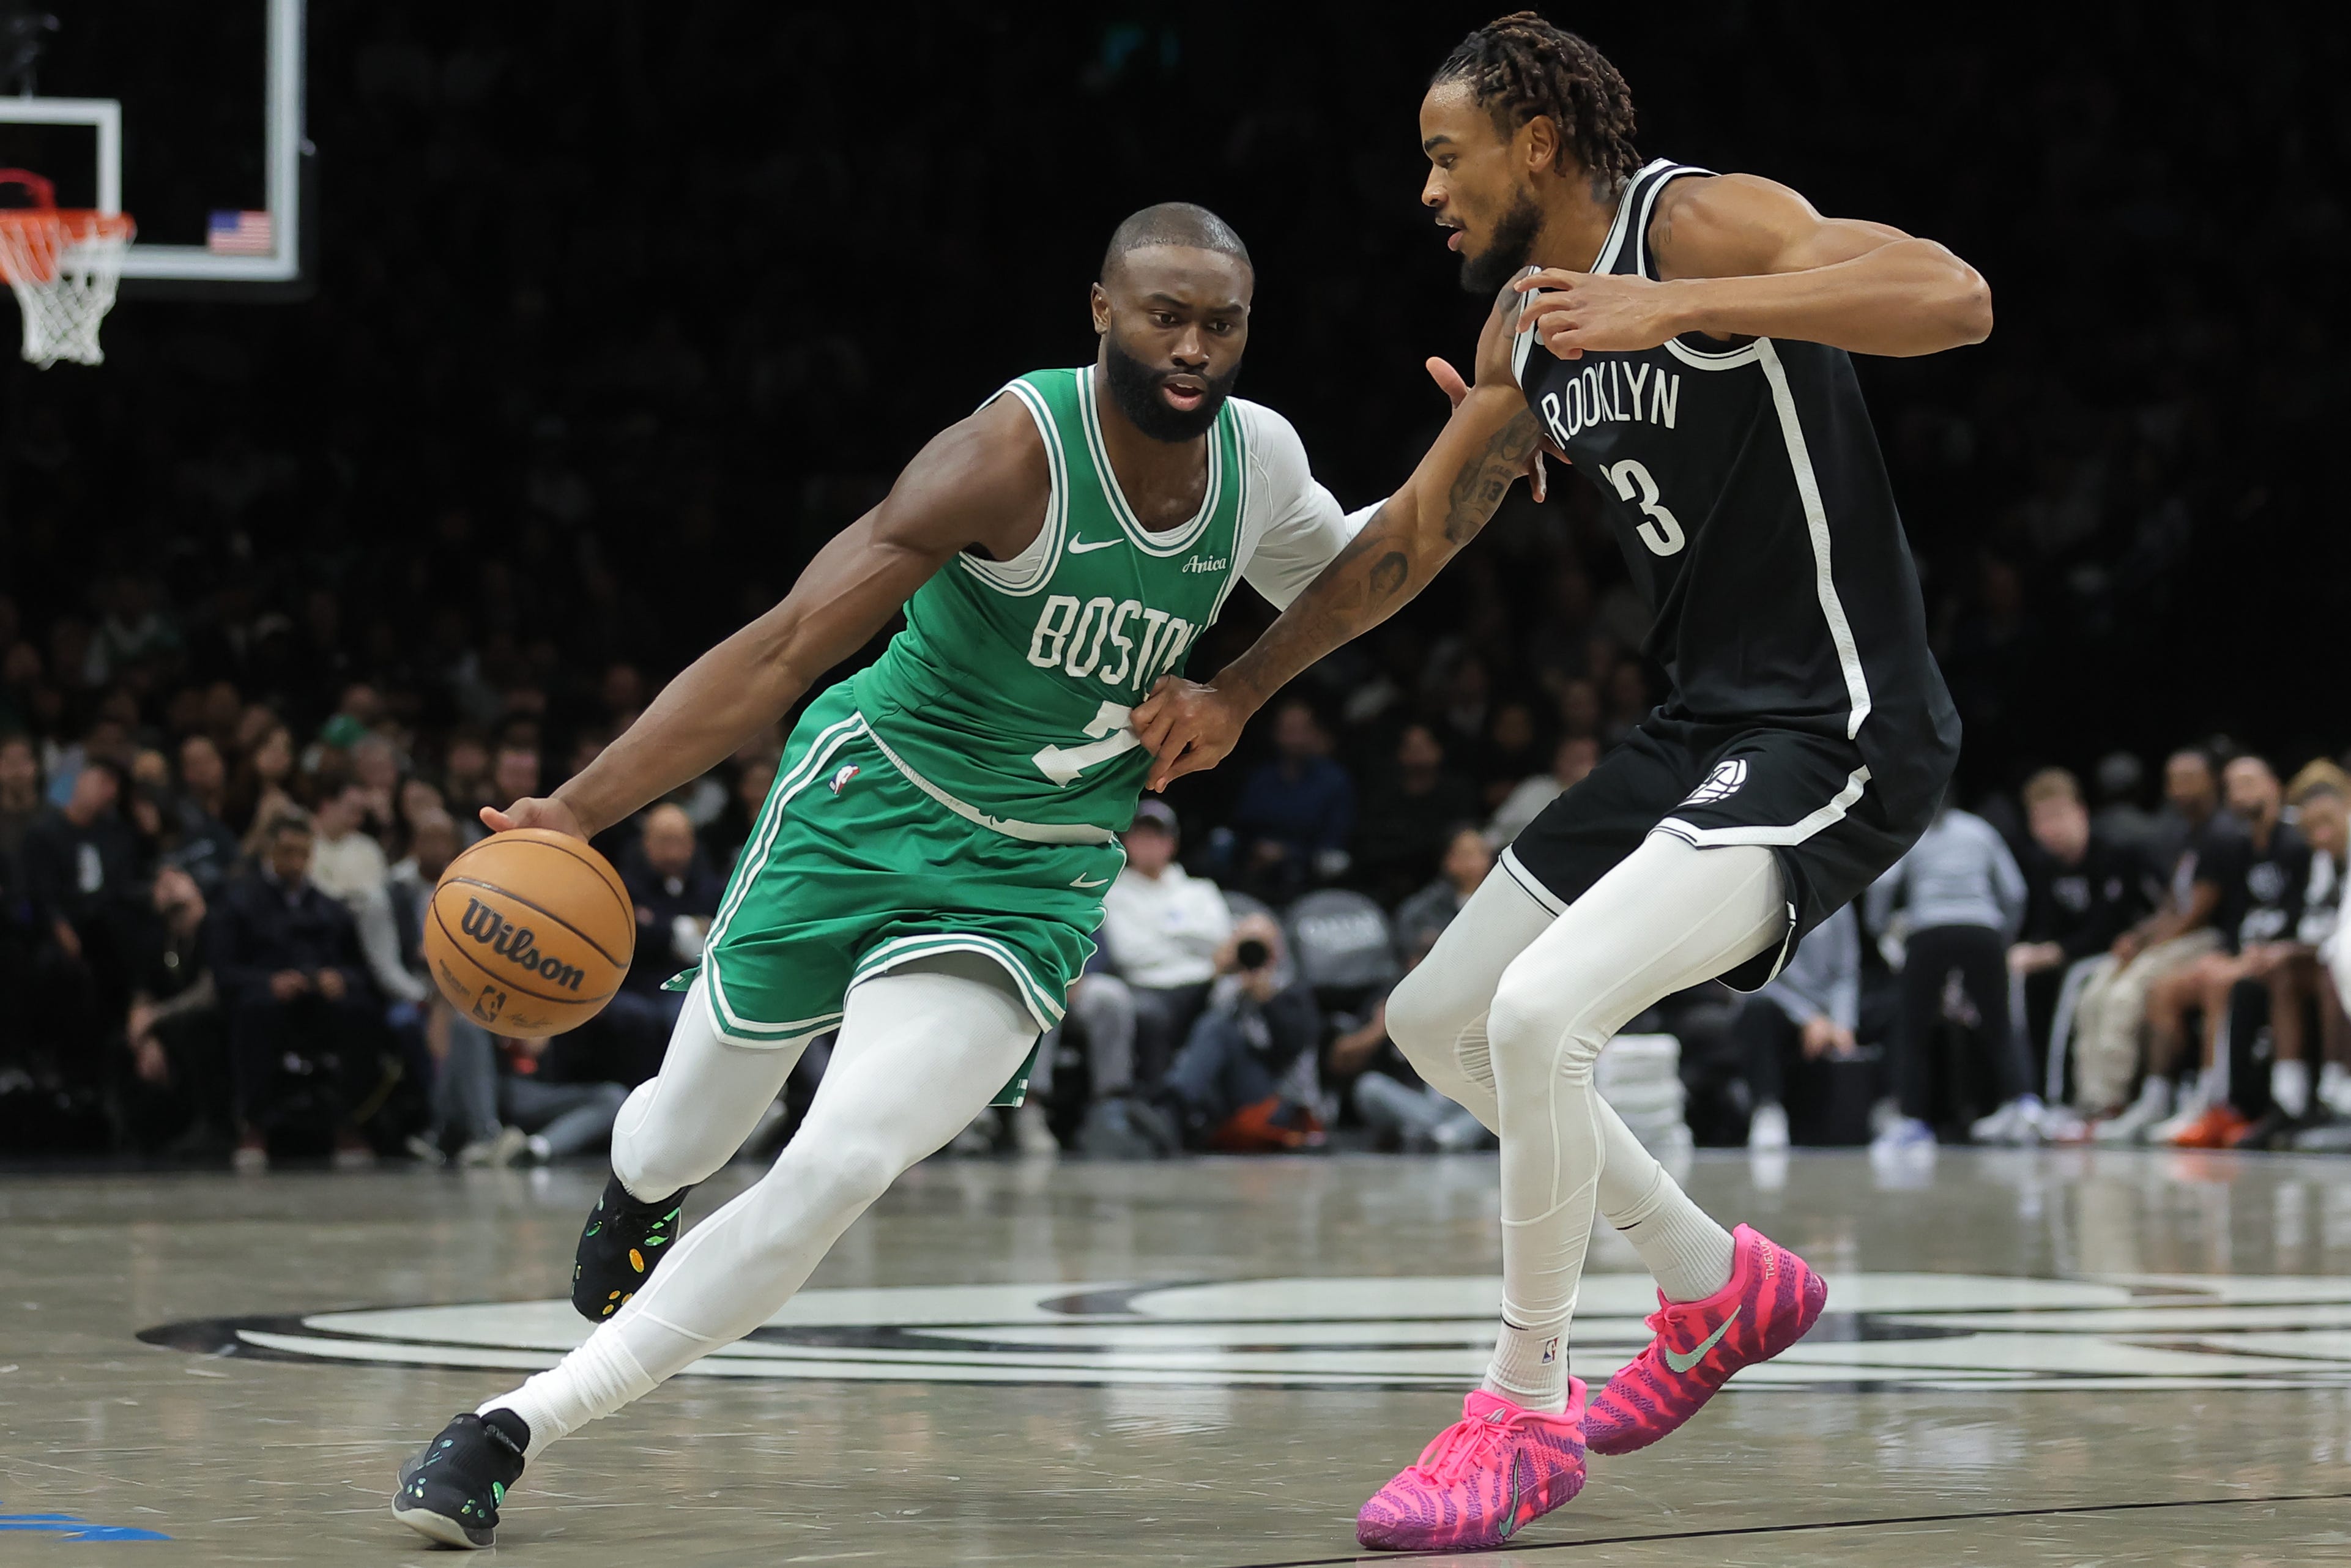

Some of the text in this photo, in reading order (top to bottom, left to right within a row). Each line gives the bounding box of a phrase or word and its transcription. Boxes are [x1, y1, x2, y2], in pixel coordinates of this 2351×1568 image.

[1540, 360, 1680, 450] ROOKLYN
[1599, 459, 1685, 557] 3
[1031, 700, 1141, 789] 7
[461, 895, 585, 992] Wilson
